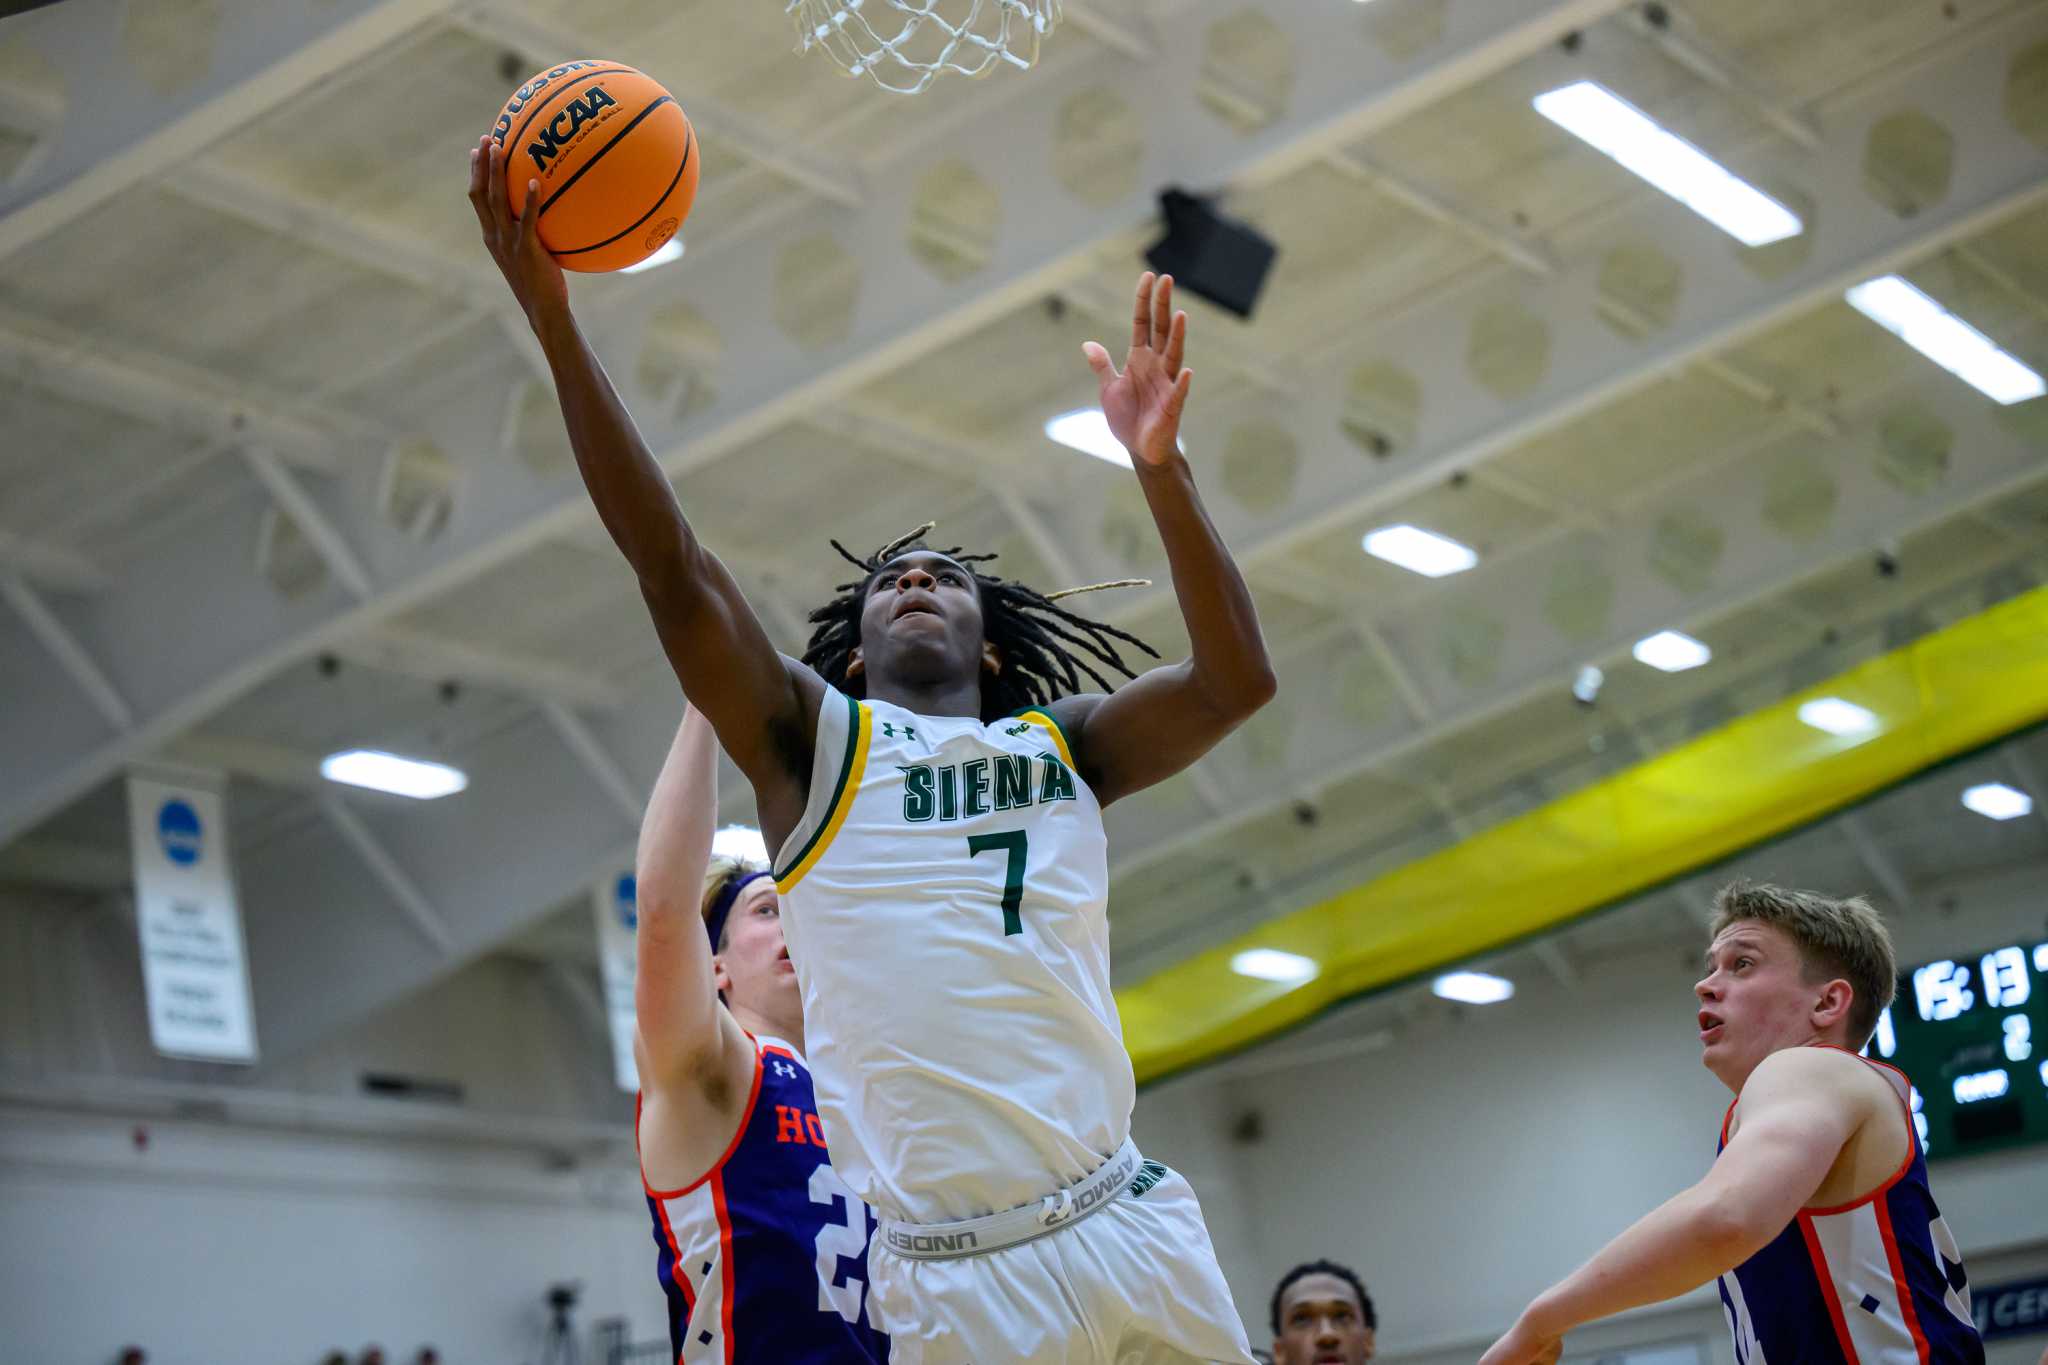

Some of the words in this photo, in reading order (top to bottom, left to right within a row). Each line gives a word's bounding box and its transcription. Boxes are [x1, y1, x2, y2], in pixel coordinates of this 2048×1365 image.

[527, 85, 617, 173] NCAA
[896, 751, 1077, 823] SIENA
[967, 829, 1029, 937] 7
[808, 1163, 890, 1336] 2
[887, 1228, 977, 1252] UNDER
